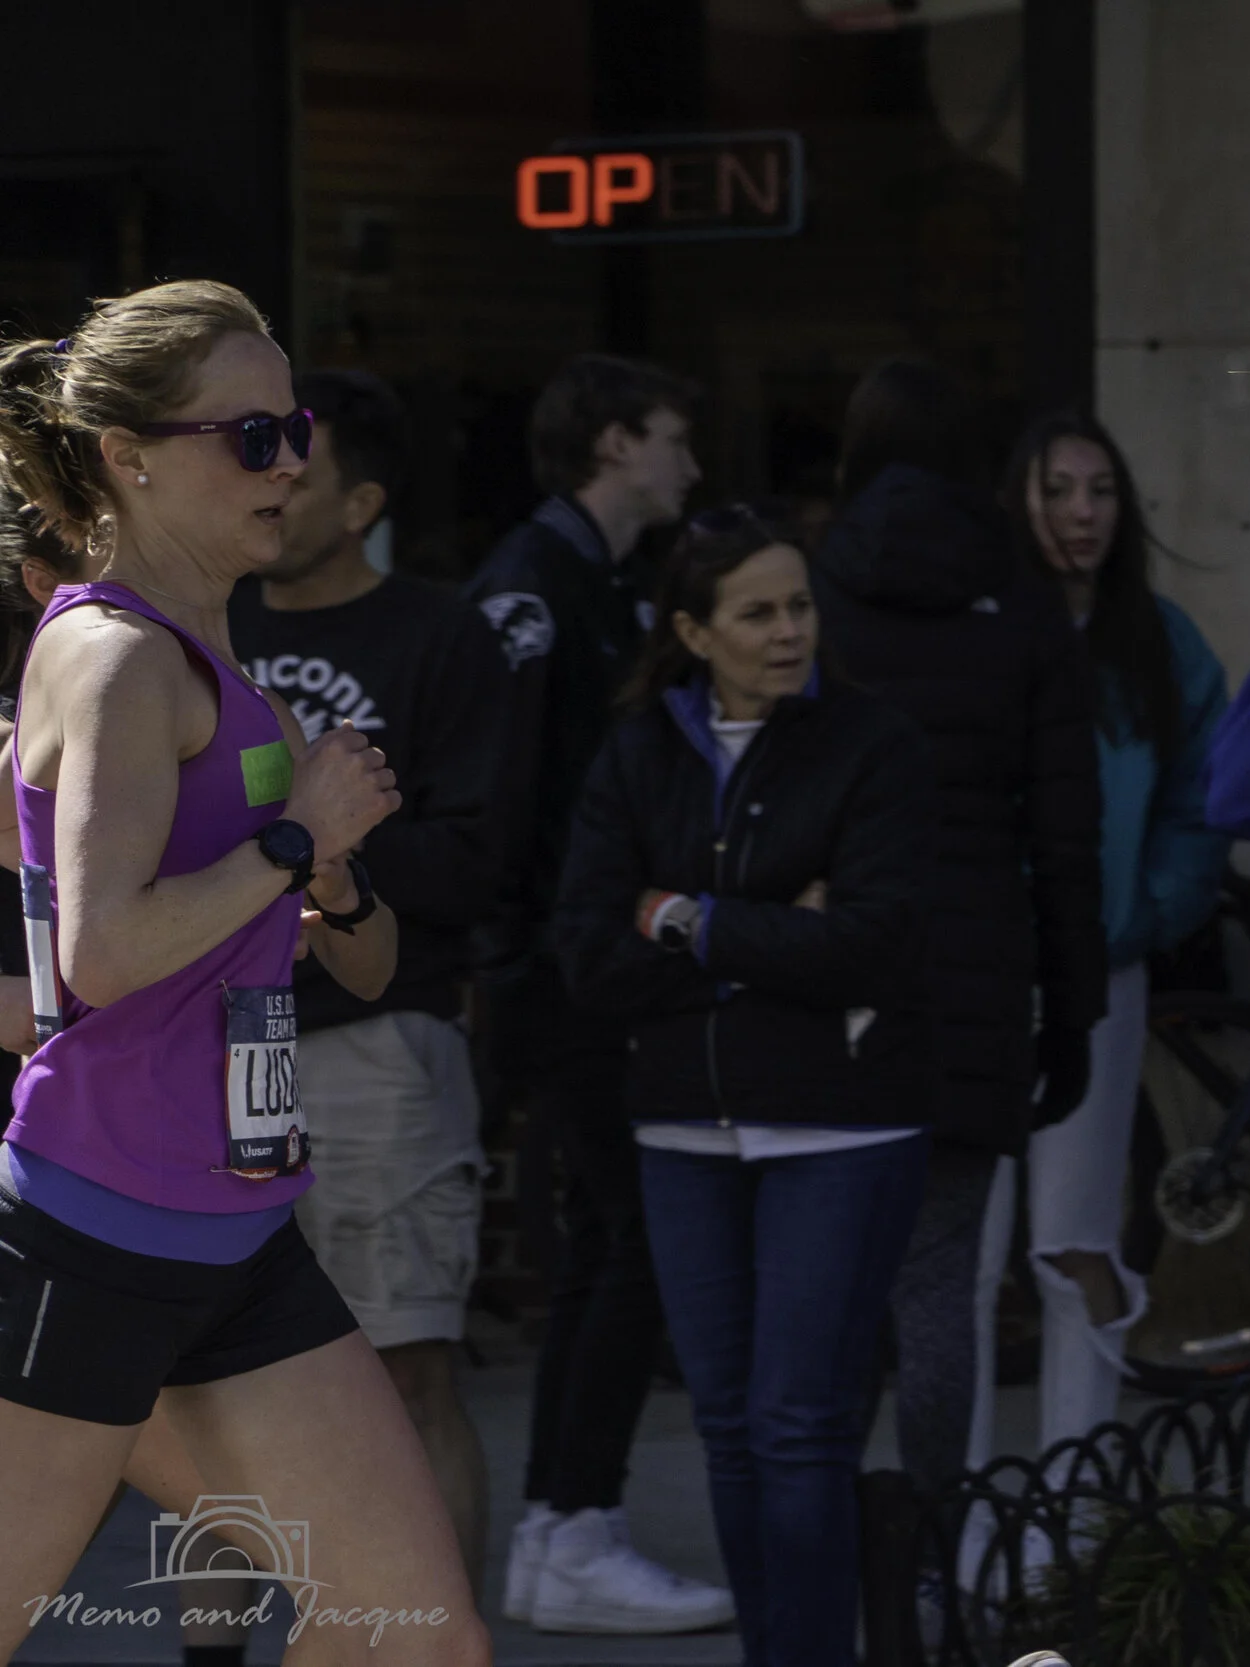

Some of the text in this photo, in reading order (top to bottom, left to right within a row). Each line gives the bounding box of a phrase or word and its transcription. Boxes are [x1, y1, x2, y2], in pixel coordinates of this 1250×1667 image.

[517, 152, 779, 230] OPEN
[266, 994, 285, 1016] U.S.
[265, 1018, 289, 1040] TEAM
[251, 1146, 274, 1157] USATF
